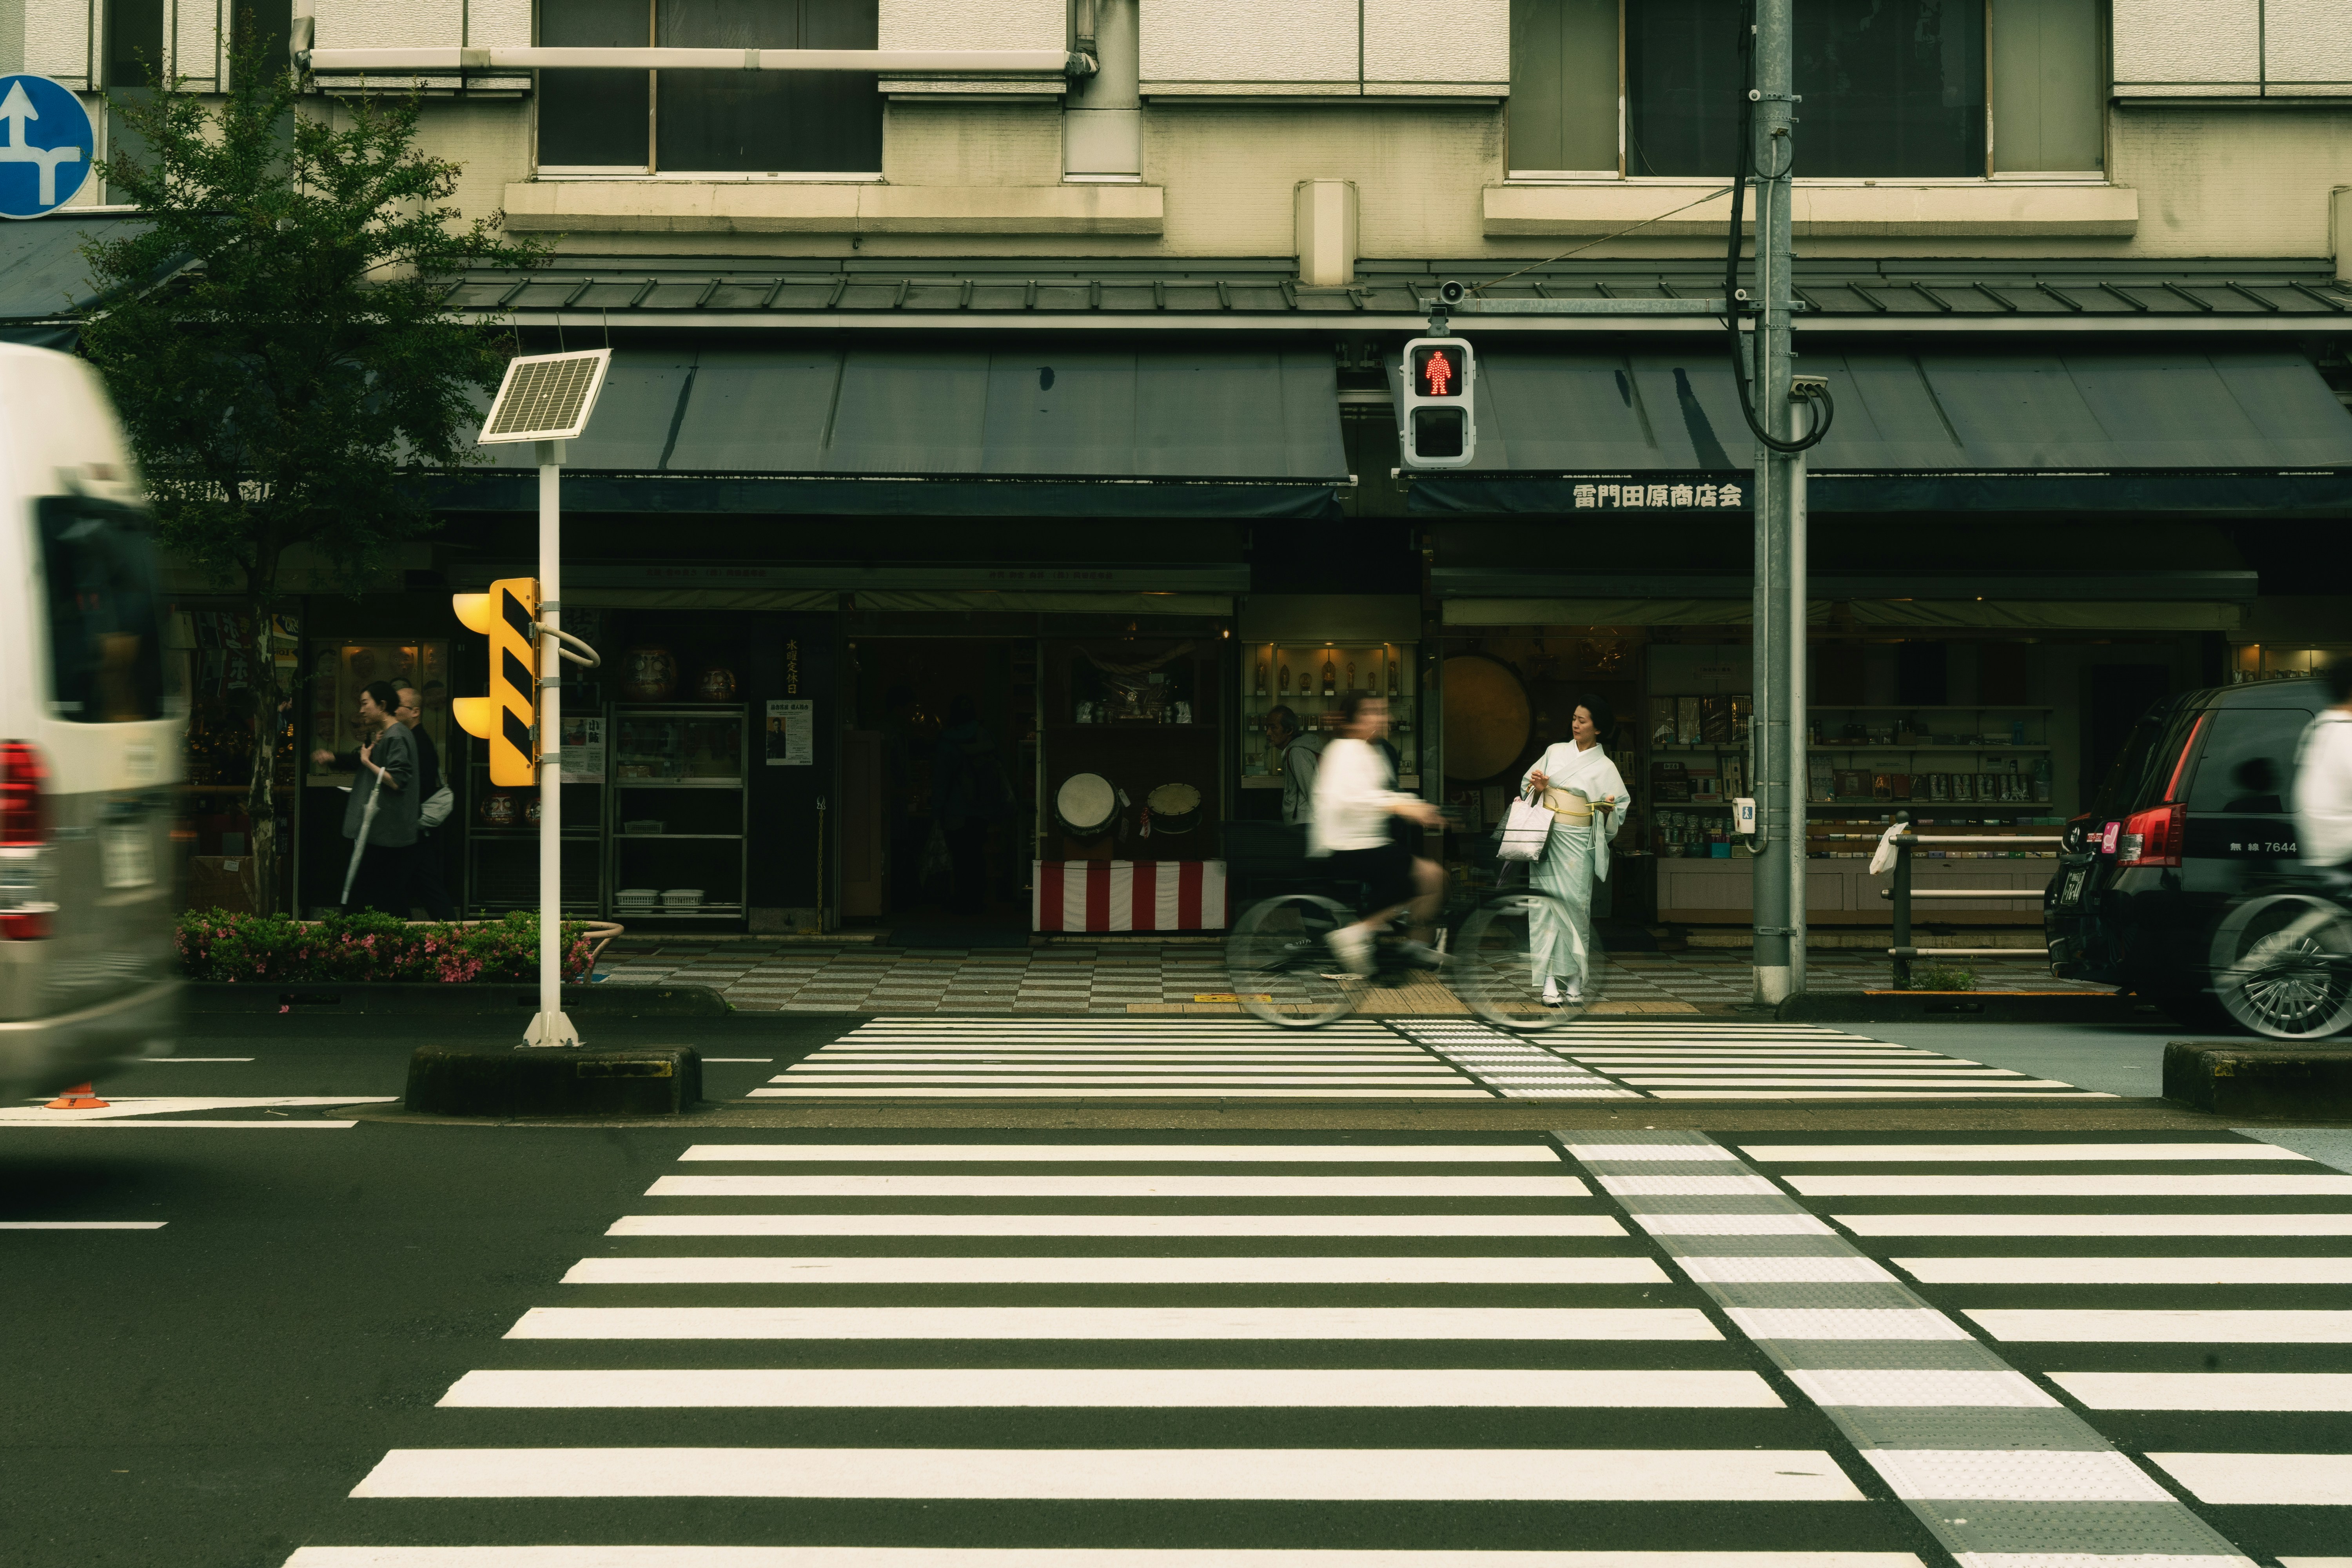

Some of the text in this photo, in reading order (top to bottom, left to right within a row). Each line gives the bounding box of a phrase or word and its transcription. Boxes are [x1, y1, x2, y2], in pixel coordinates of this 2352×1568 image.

[1573, 484, 1742, 508] 雷門田原商店会
[786, 639, 798, 695] 水曜定休日
[2265, 842, 2297, 853] 7644
